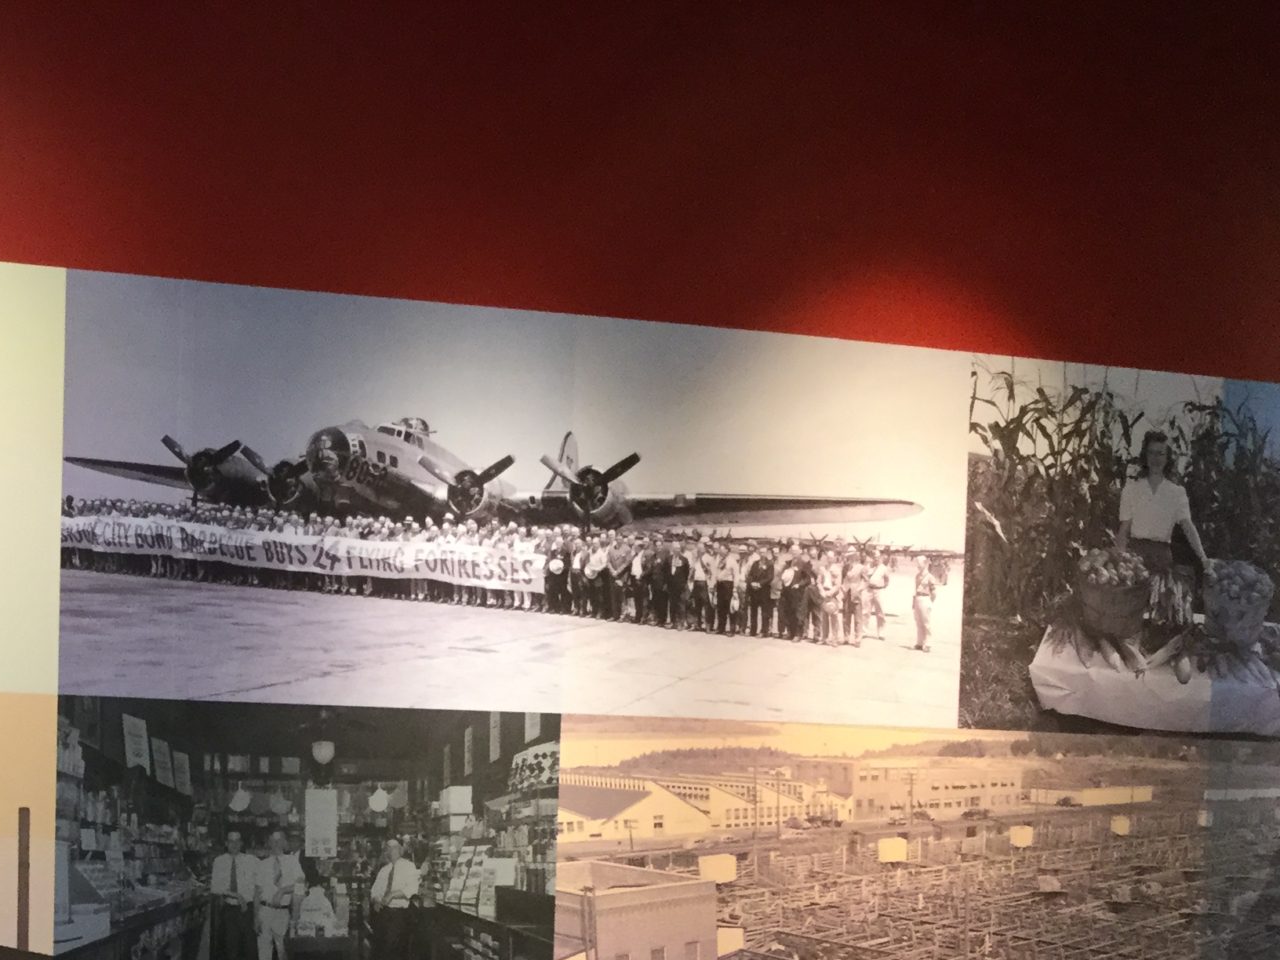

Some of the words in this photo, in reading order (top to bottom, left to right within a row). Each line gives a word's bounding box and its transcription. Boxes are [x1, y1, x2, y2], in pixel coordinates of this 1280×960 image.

[104, 522, 131, 549] CITY
[263, 540, 308, 566] BUYS
[312, 541, 341, 572] 24
[346, 546, 406, 576] FLYING
[414, 550, 533, 586] FORTRESSES
